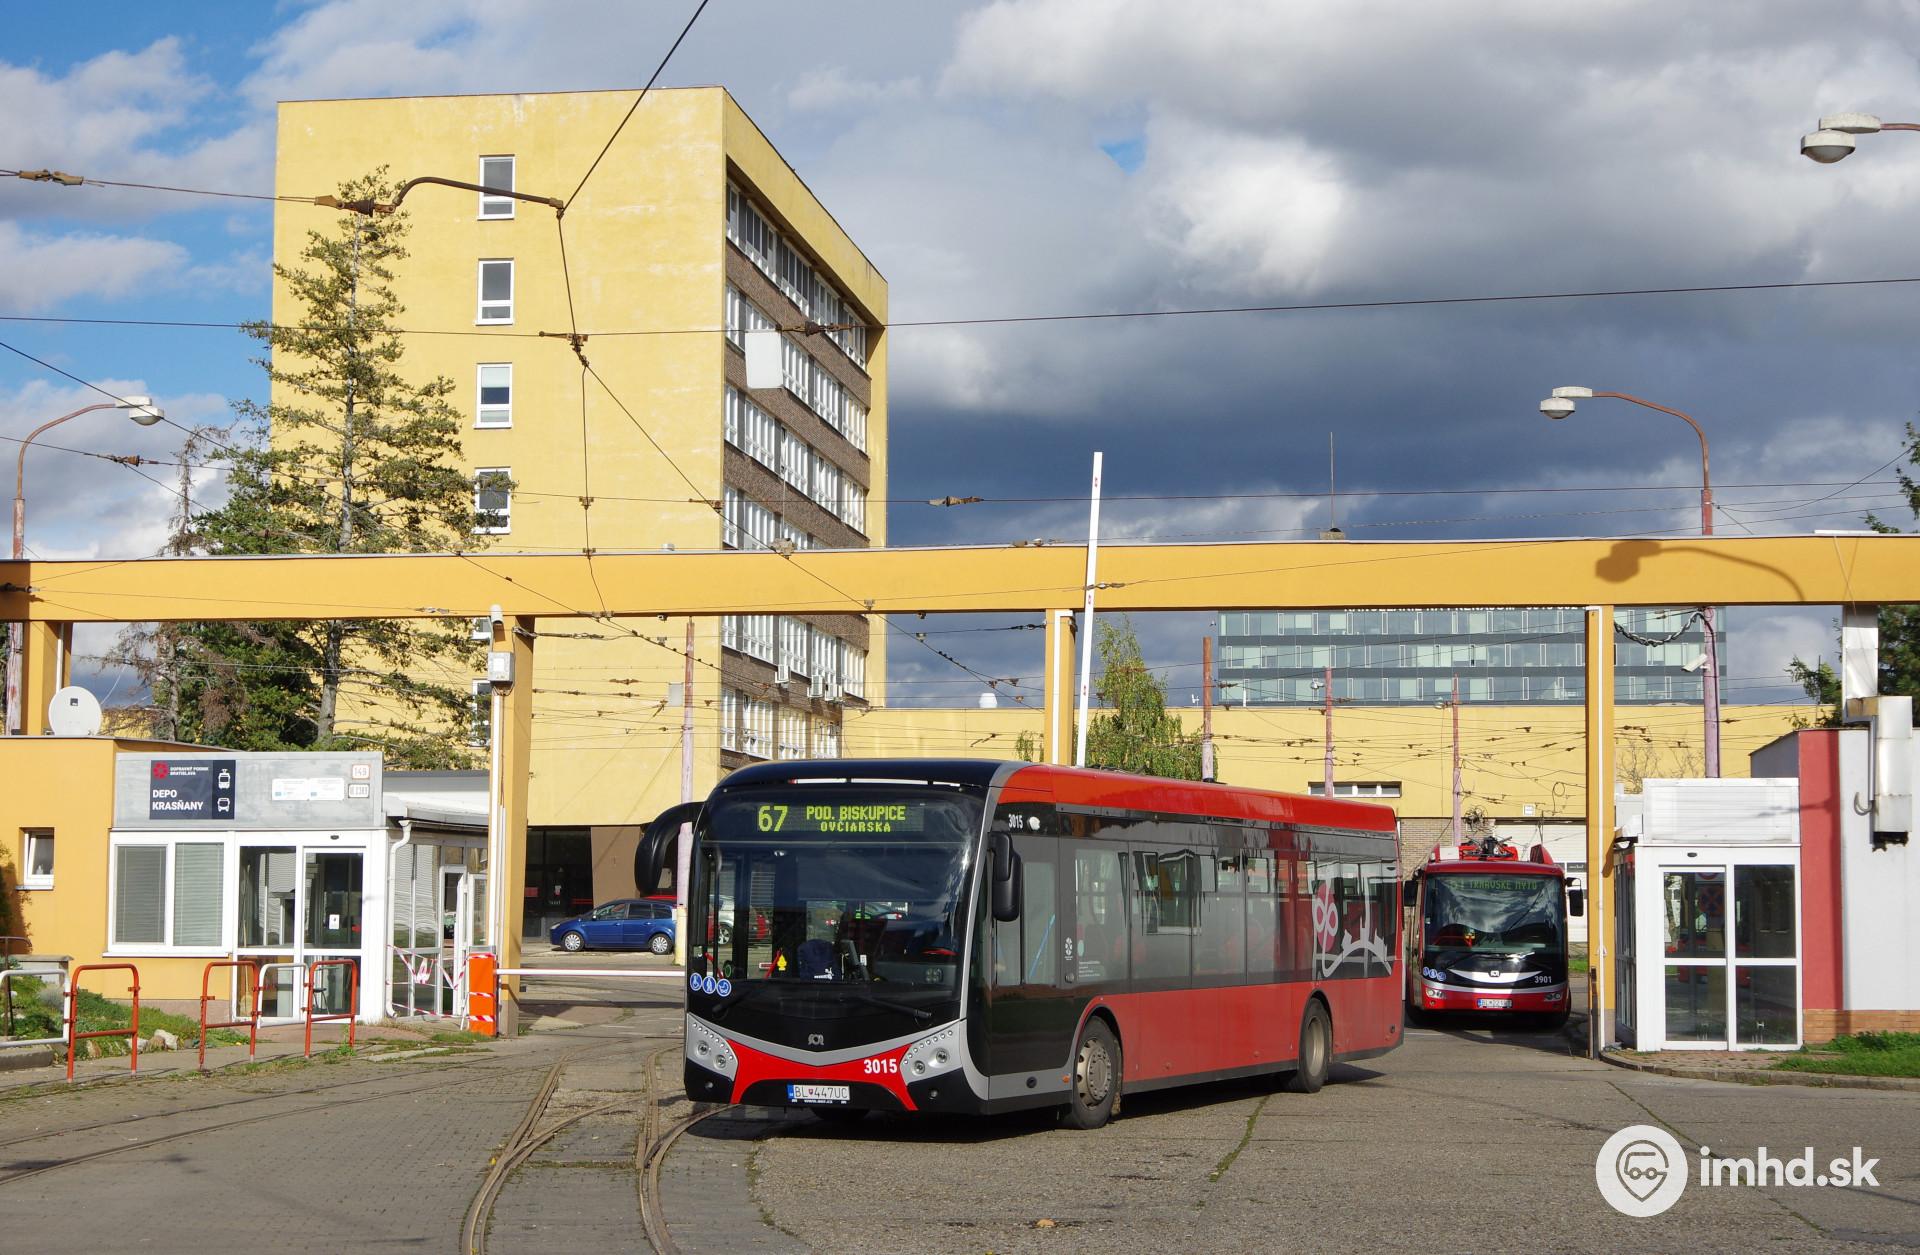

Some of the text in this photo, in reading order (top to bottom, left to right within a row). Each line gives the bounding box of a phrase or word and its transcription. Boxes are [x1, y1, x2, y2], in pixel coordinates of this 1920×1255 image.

[152, 789, 178, 798] DEPO
[152, 799, 204, 811] KRASŇANY
[758, 805, 906, 832] 67 POD. BISKUPICE
[1008, 813, 1024, 829] 3015
[820, 820, 891, 832] OVČIARSKA
[1534, 975, 1552, 983] 3901
[863, 1058, 898, 1074] 3015
[795, 1086, 808, 1098] BL
[814, 1087, 848, 1099] 447UC
